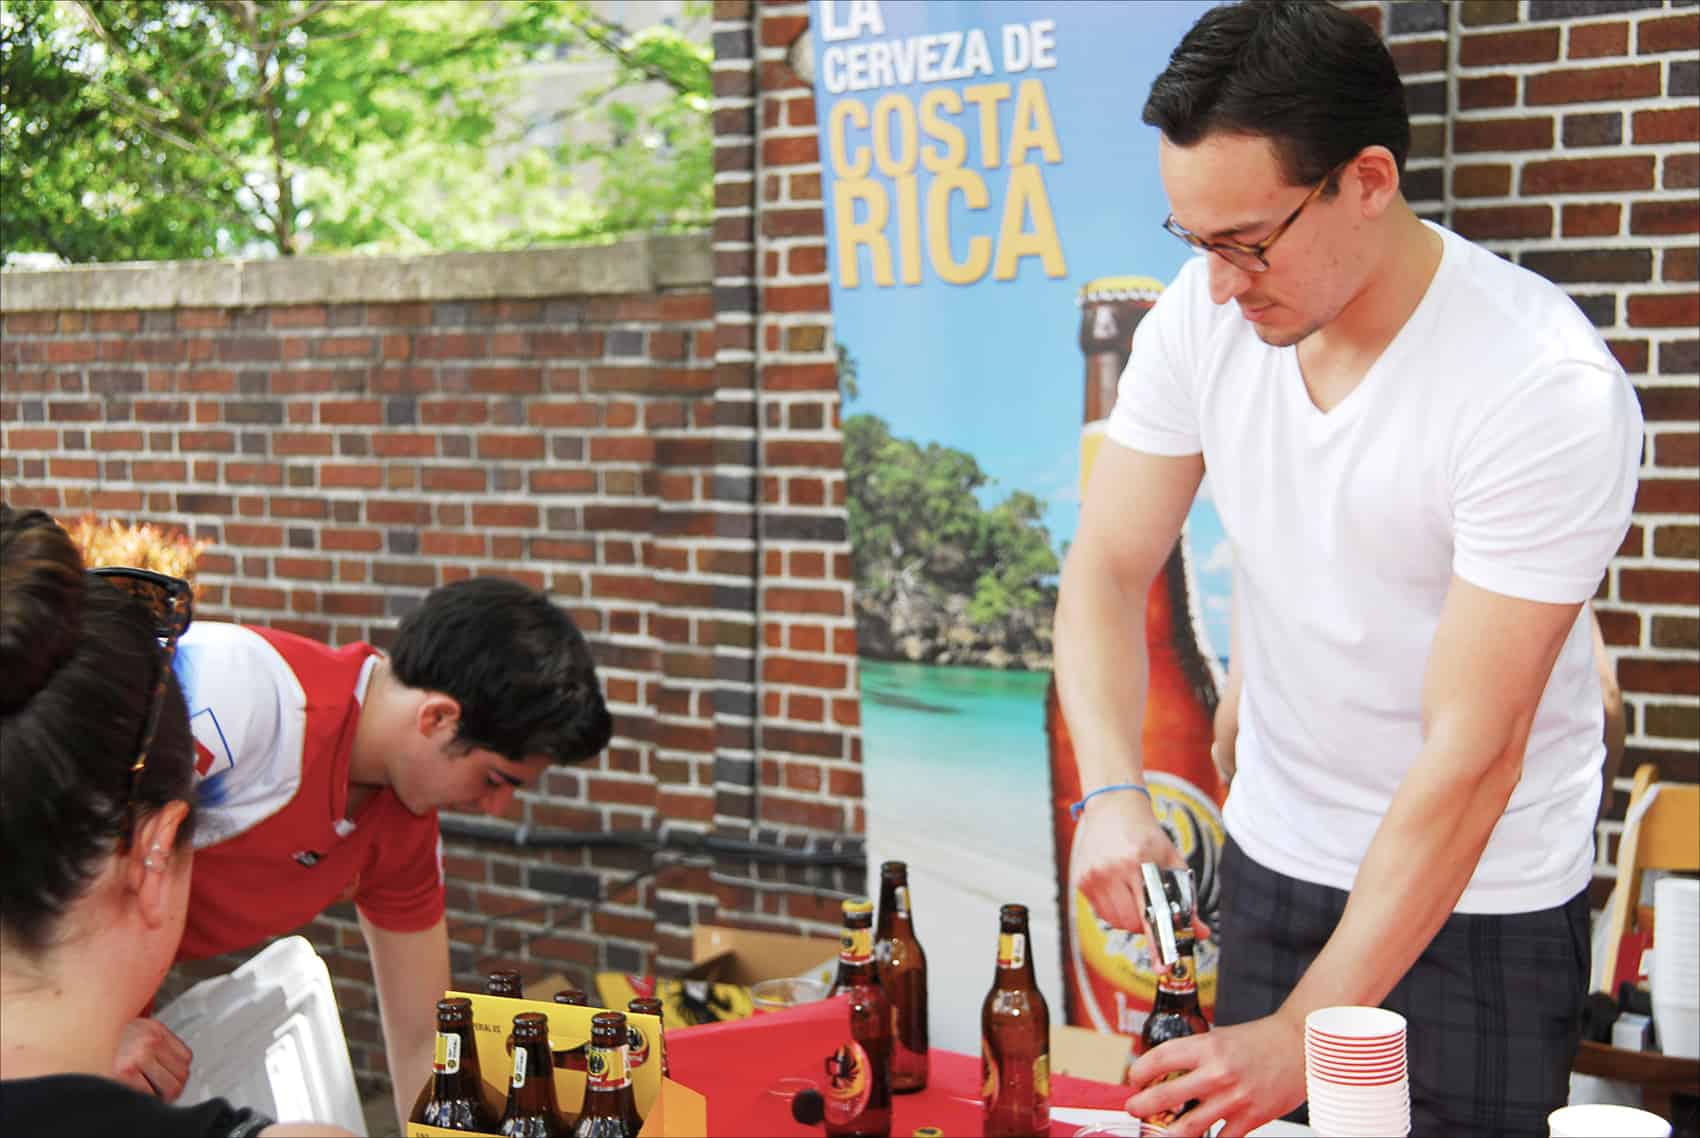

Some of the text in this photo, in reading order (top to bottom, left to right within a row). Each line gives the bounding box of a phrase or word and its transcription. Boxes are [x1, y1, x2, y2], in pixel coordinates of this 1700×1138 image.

[820, 0, 885, 41] LA
[823, 20, 1057, 93] CERVEZA DE
[829, 79, 1063, 180] COSTA
[833, 164, 1068, 288] RICA
